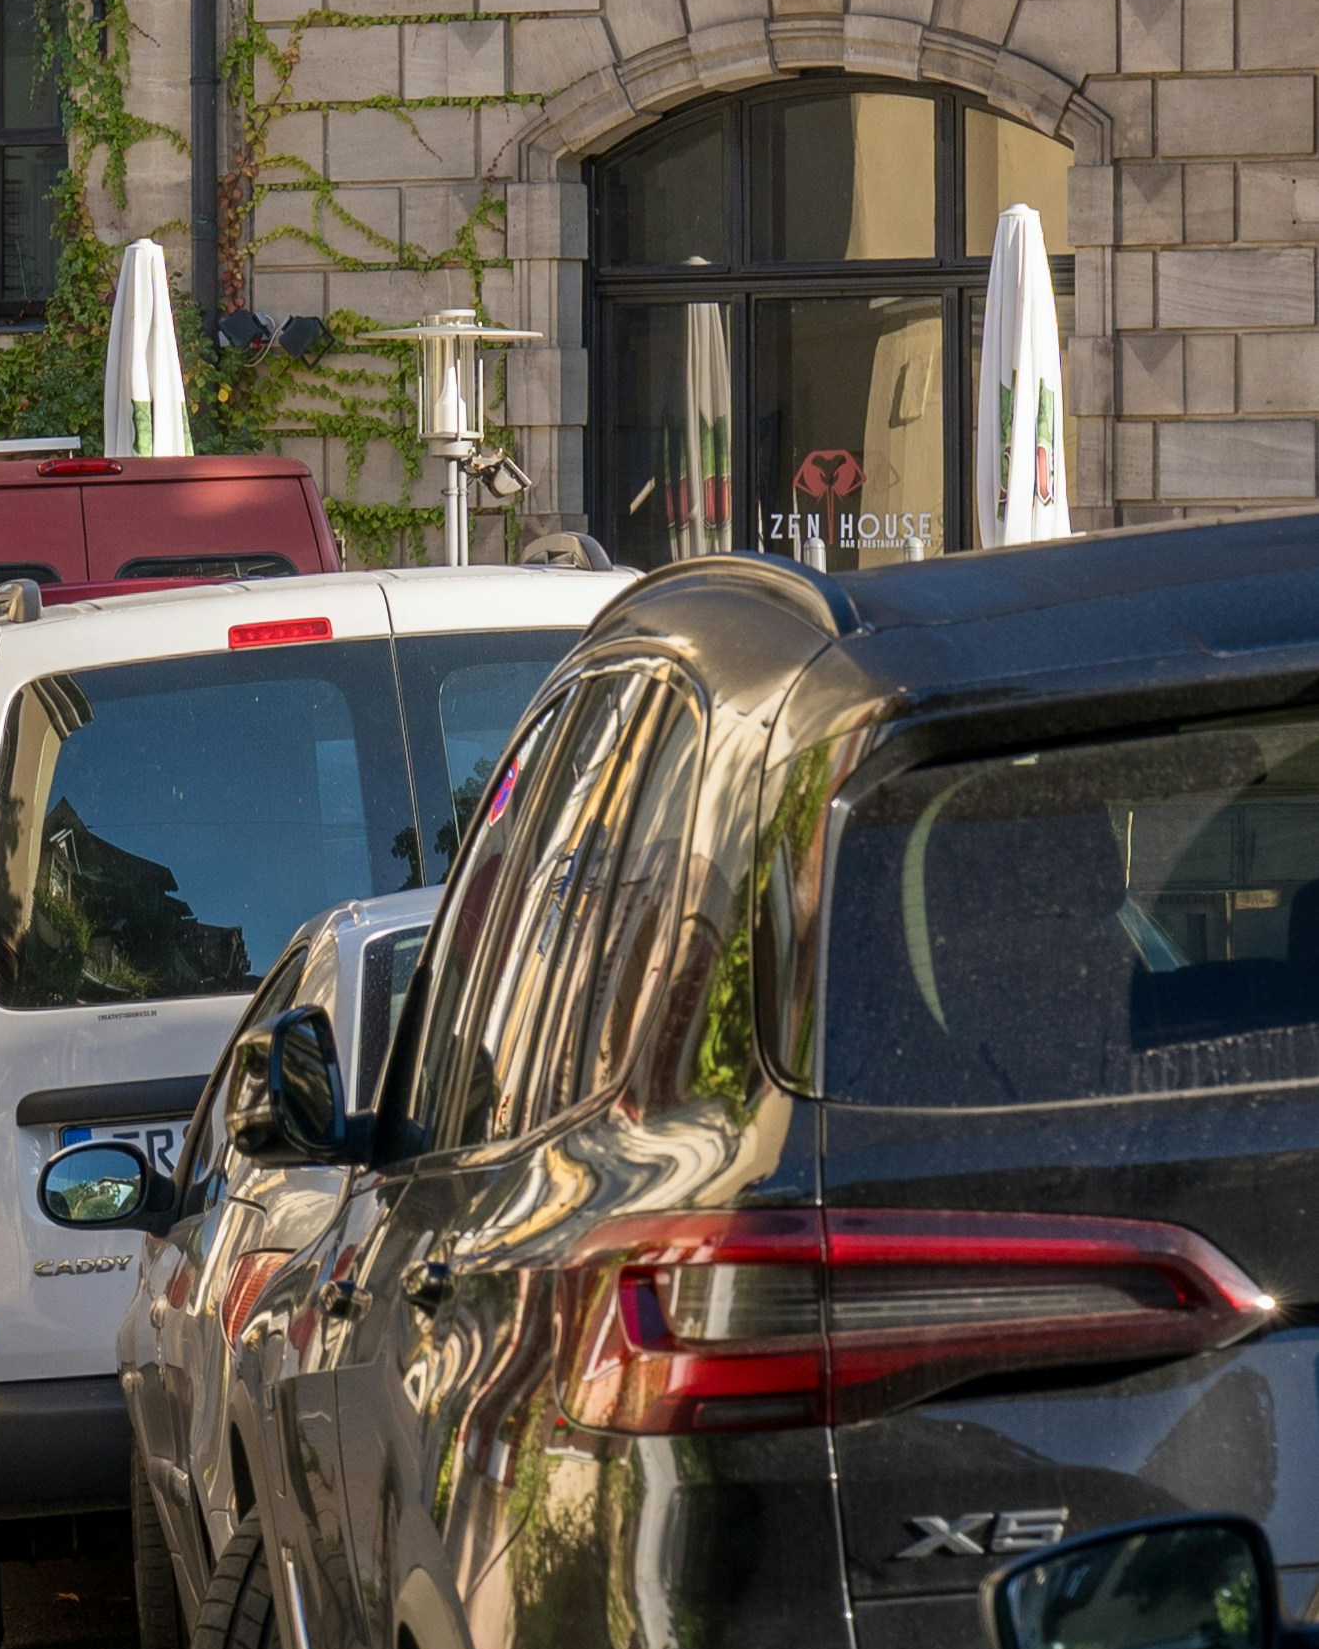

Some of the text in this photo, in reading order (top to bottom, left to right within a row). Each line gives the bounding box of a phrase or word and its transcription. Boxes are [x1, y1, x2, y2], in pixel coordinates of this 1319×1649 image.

[770, 513, 931, 539] ZEN HOUSE
[33, 1254, 133, 1278] CADDY
[891, 1506, 1069, 1559] X5
